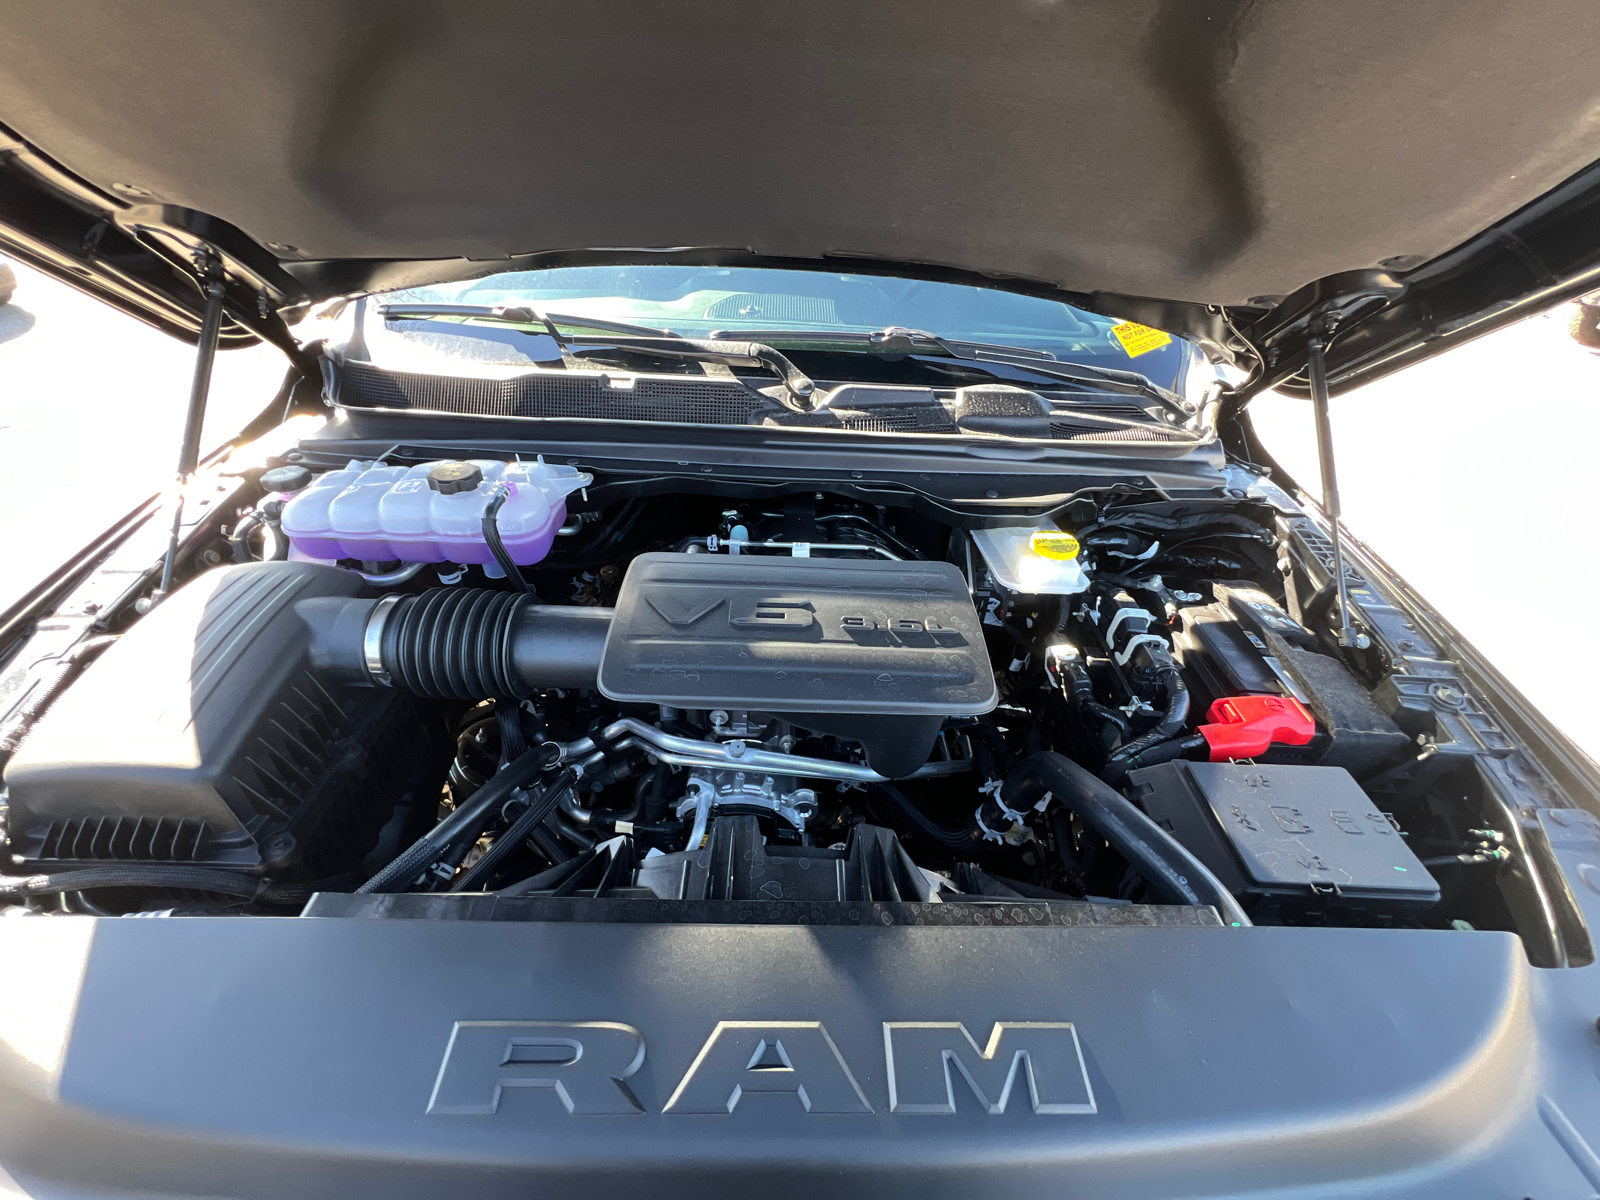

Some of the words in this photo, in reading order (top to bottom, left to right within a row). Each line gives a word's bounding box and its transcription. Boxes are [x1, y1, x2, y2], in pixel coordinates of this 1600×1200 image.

[1115, 324, 1131, 334] THIS
[1122, 332, 1134, 341] NOT
[1135, 328, 1145, 337] FOR
[644, 594, 816, 628] V6
[425, 1020, 1098, 1115] RAM
